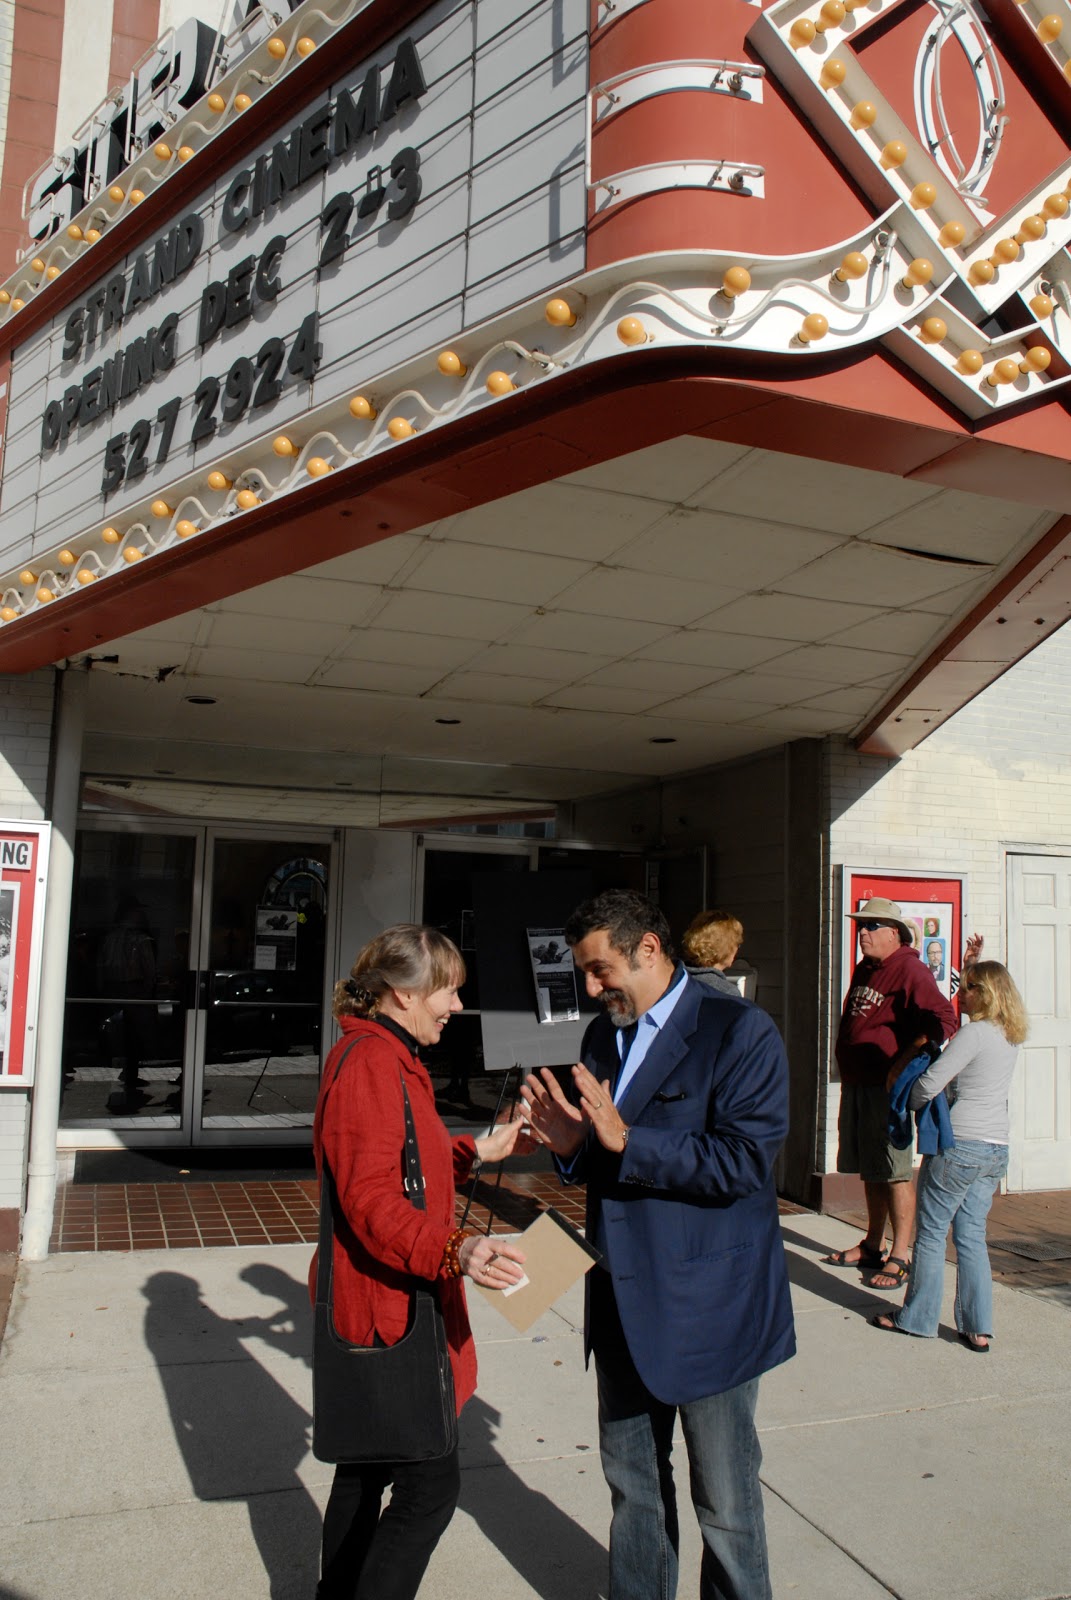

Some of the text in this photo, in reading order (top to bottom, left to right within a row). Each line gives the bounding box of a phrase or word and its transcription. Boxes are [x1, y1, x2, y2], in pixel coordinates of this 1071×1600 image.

[62, 37, 428, 361] STRAND CINEMA
[42, 312, 180, 451] OPENING
[201, 235, 288, 346] DEC
[101, 311, 324, 492] 527 2924
[0, 841, 29, 866] NG
